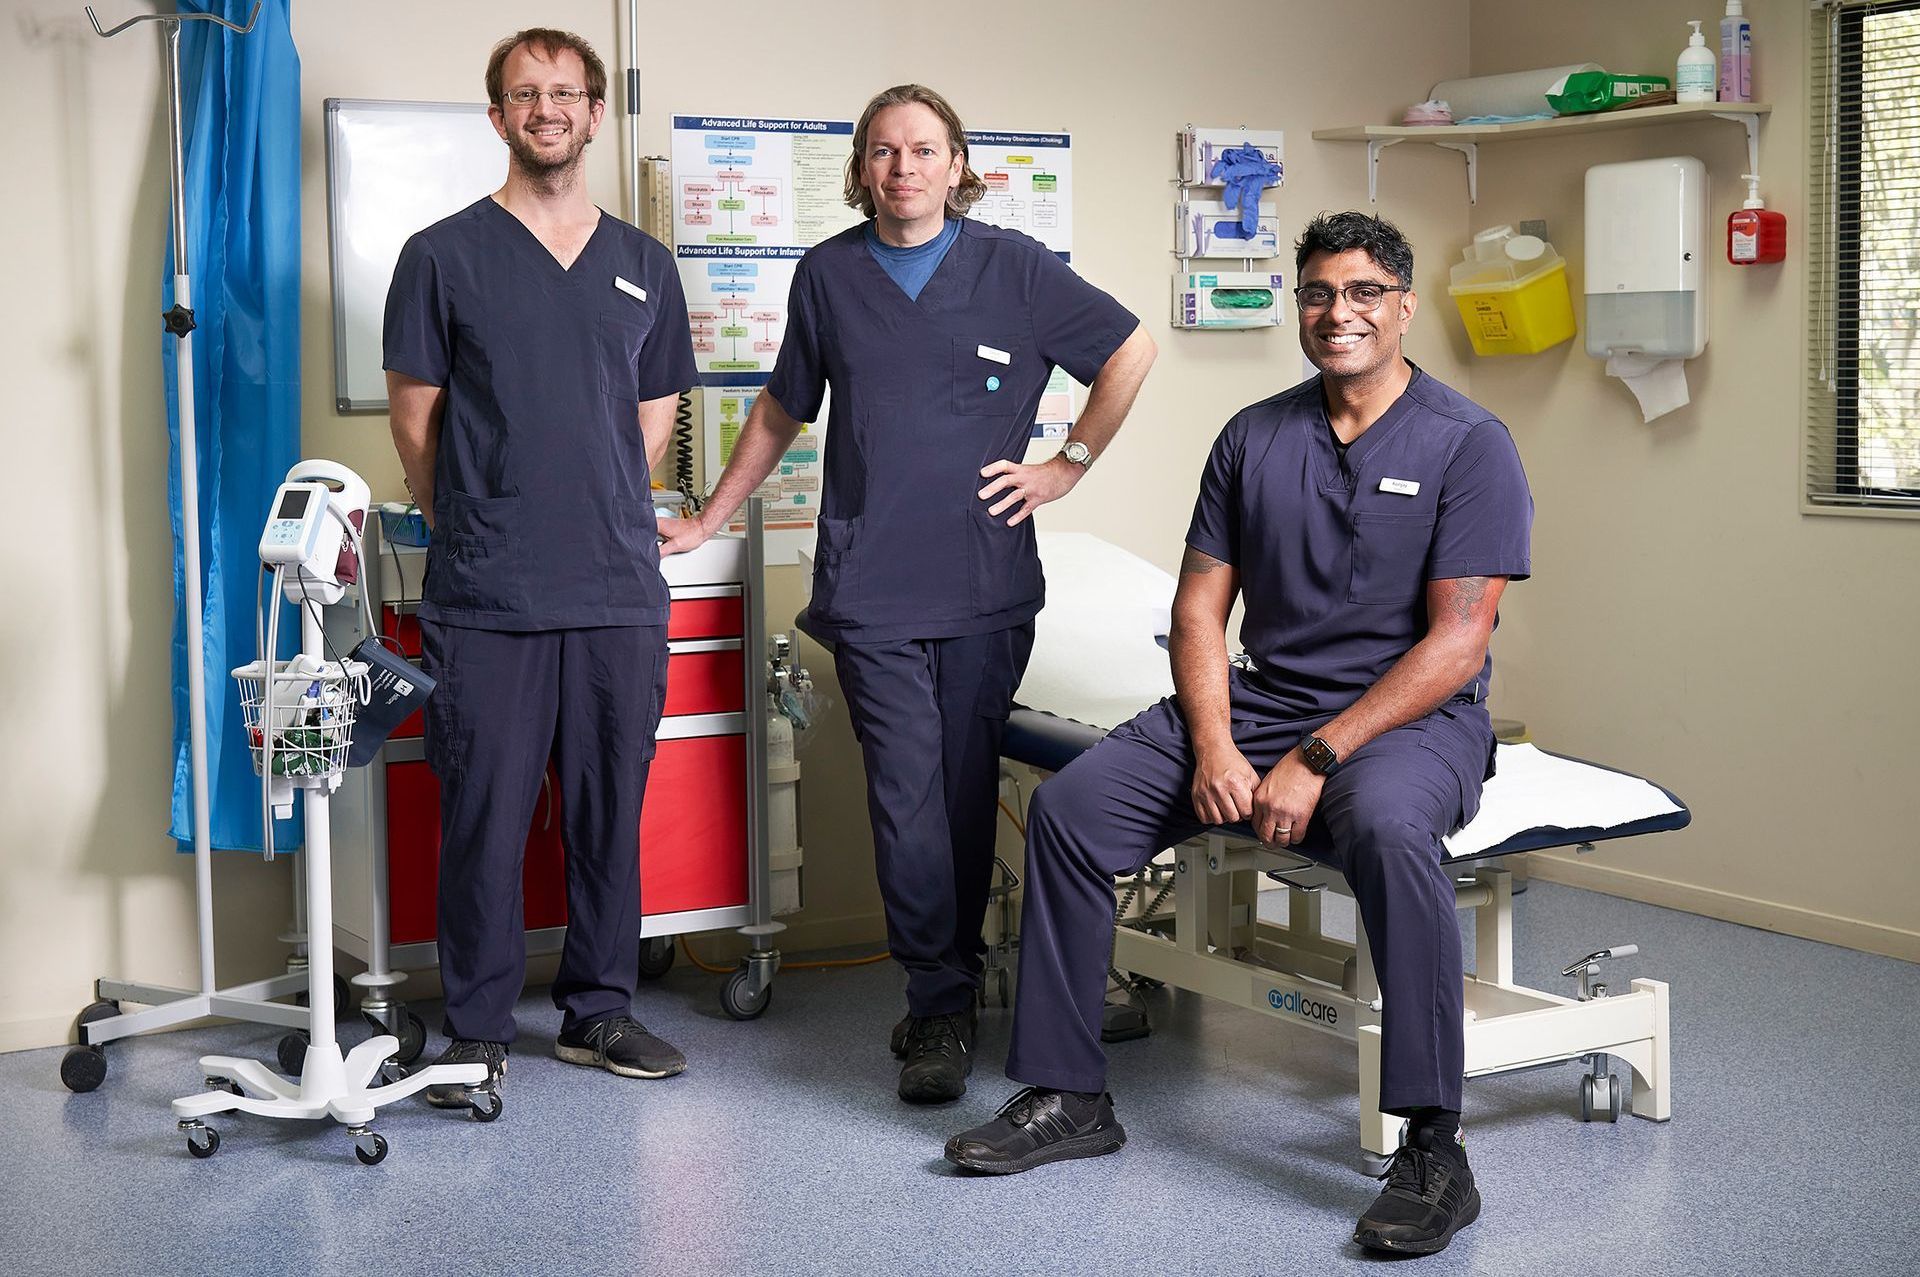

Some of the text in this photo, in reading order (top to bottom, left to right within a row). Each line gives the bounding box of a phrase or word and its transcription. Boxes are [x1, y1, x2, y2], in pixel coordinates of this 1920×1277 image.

[701, 119, 828, 131] Advanced Life Support for Adults
[678, 247, 805, 257] Advanced Life Support for Infants
[1284, 991, 1338, 1024] allcare
